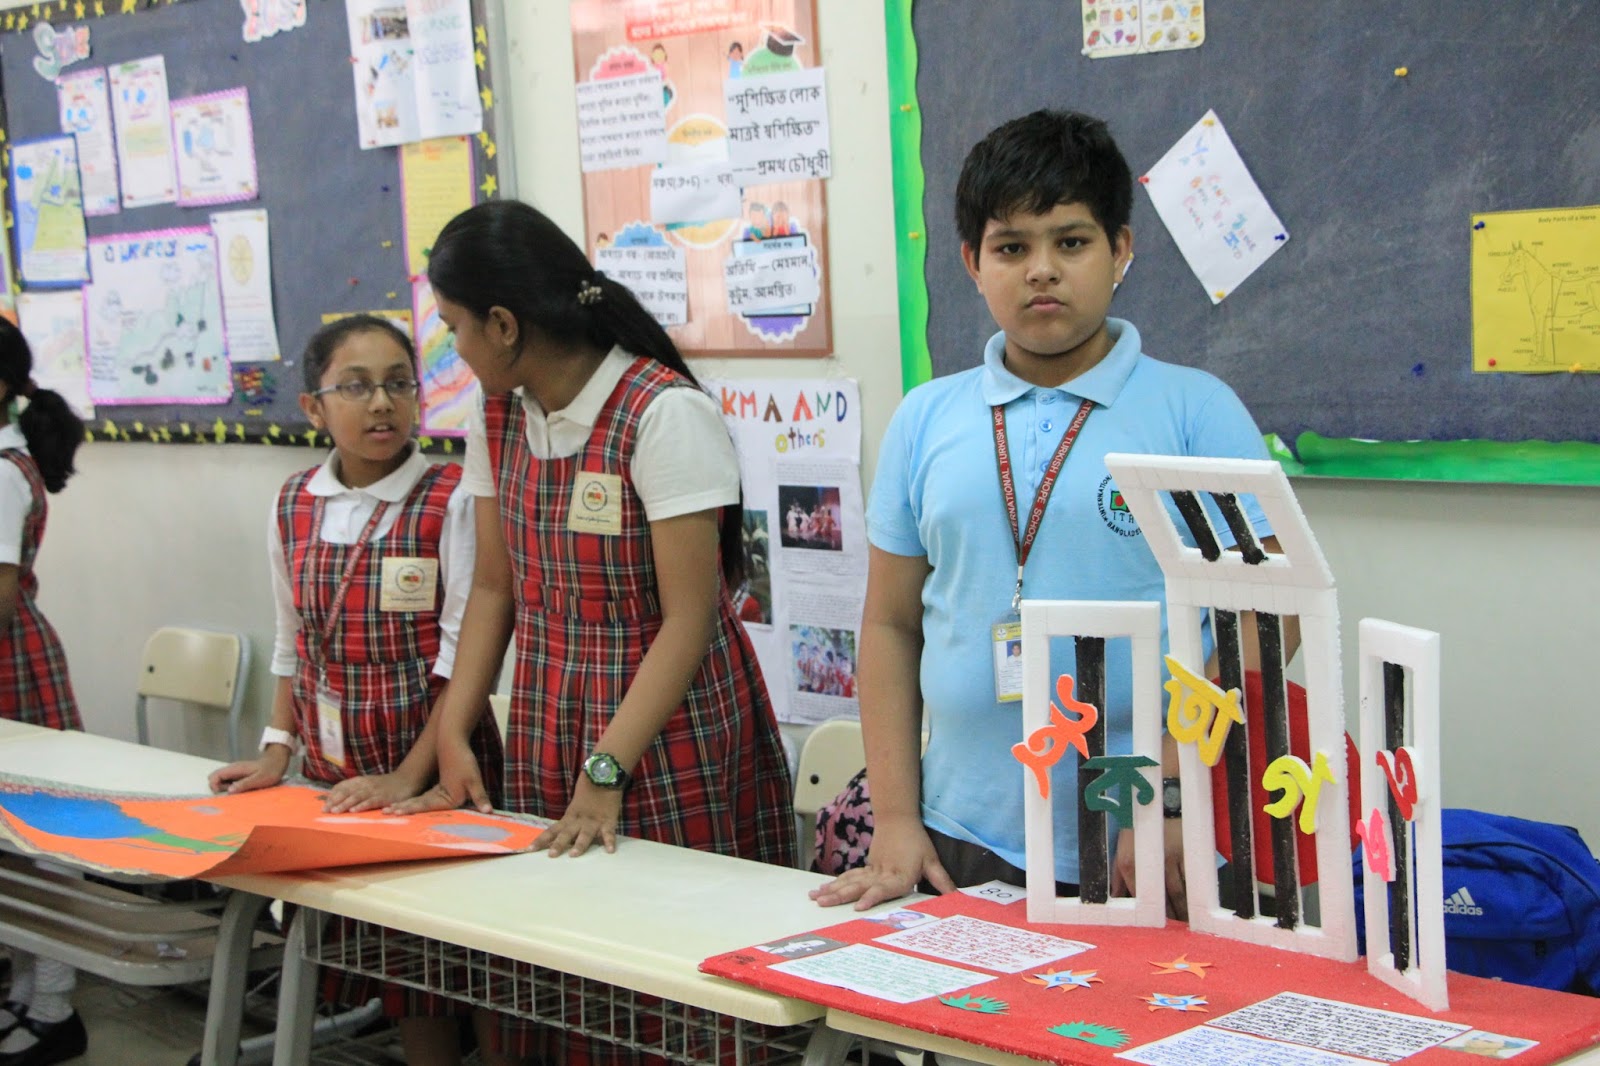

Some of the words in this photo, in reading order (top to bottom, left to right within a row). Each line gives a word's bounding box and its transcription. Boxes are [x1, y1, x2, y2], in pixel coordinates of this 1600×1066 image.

[792, 390, 848, 422] AND
[775, 426, 826, 454] others
[996, 428, 1008, 465] TURKISH
[1048, 436, 1074, 473] TURKISH
[1037, 476, 1054, 504] HOPE
[1023, 508, 1043, 547] SCHOOL
[1443, 904, 1484, 916] adidas
